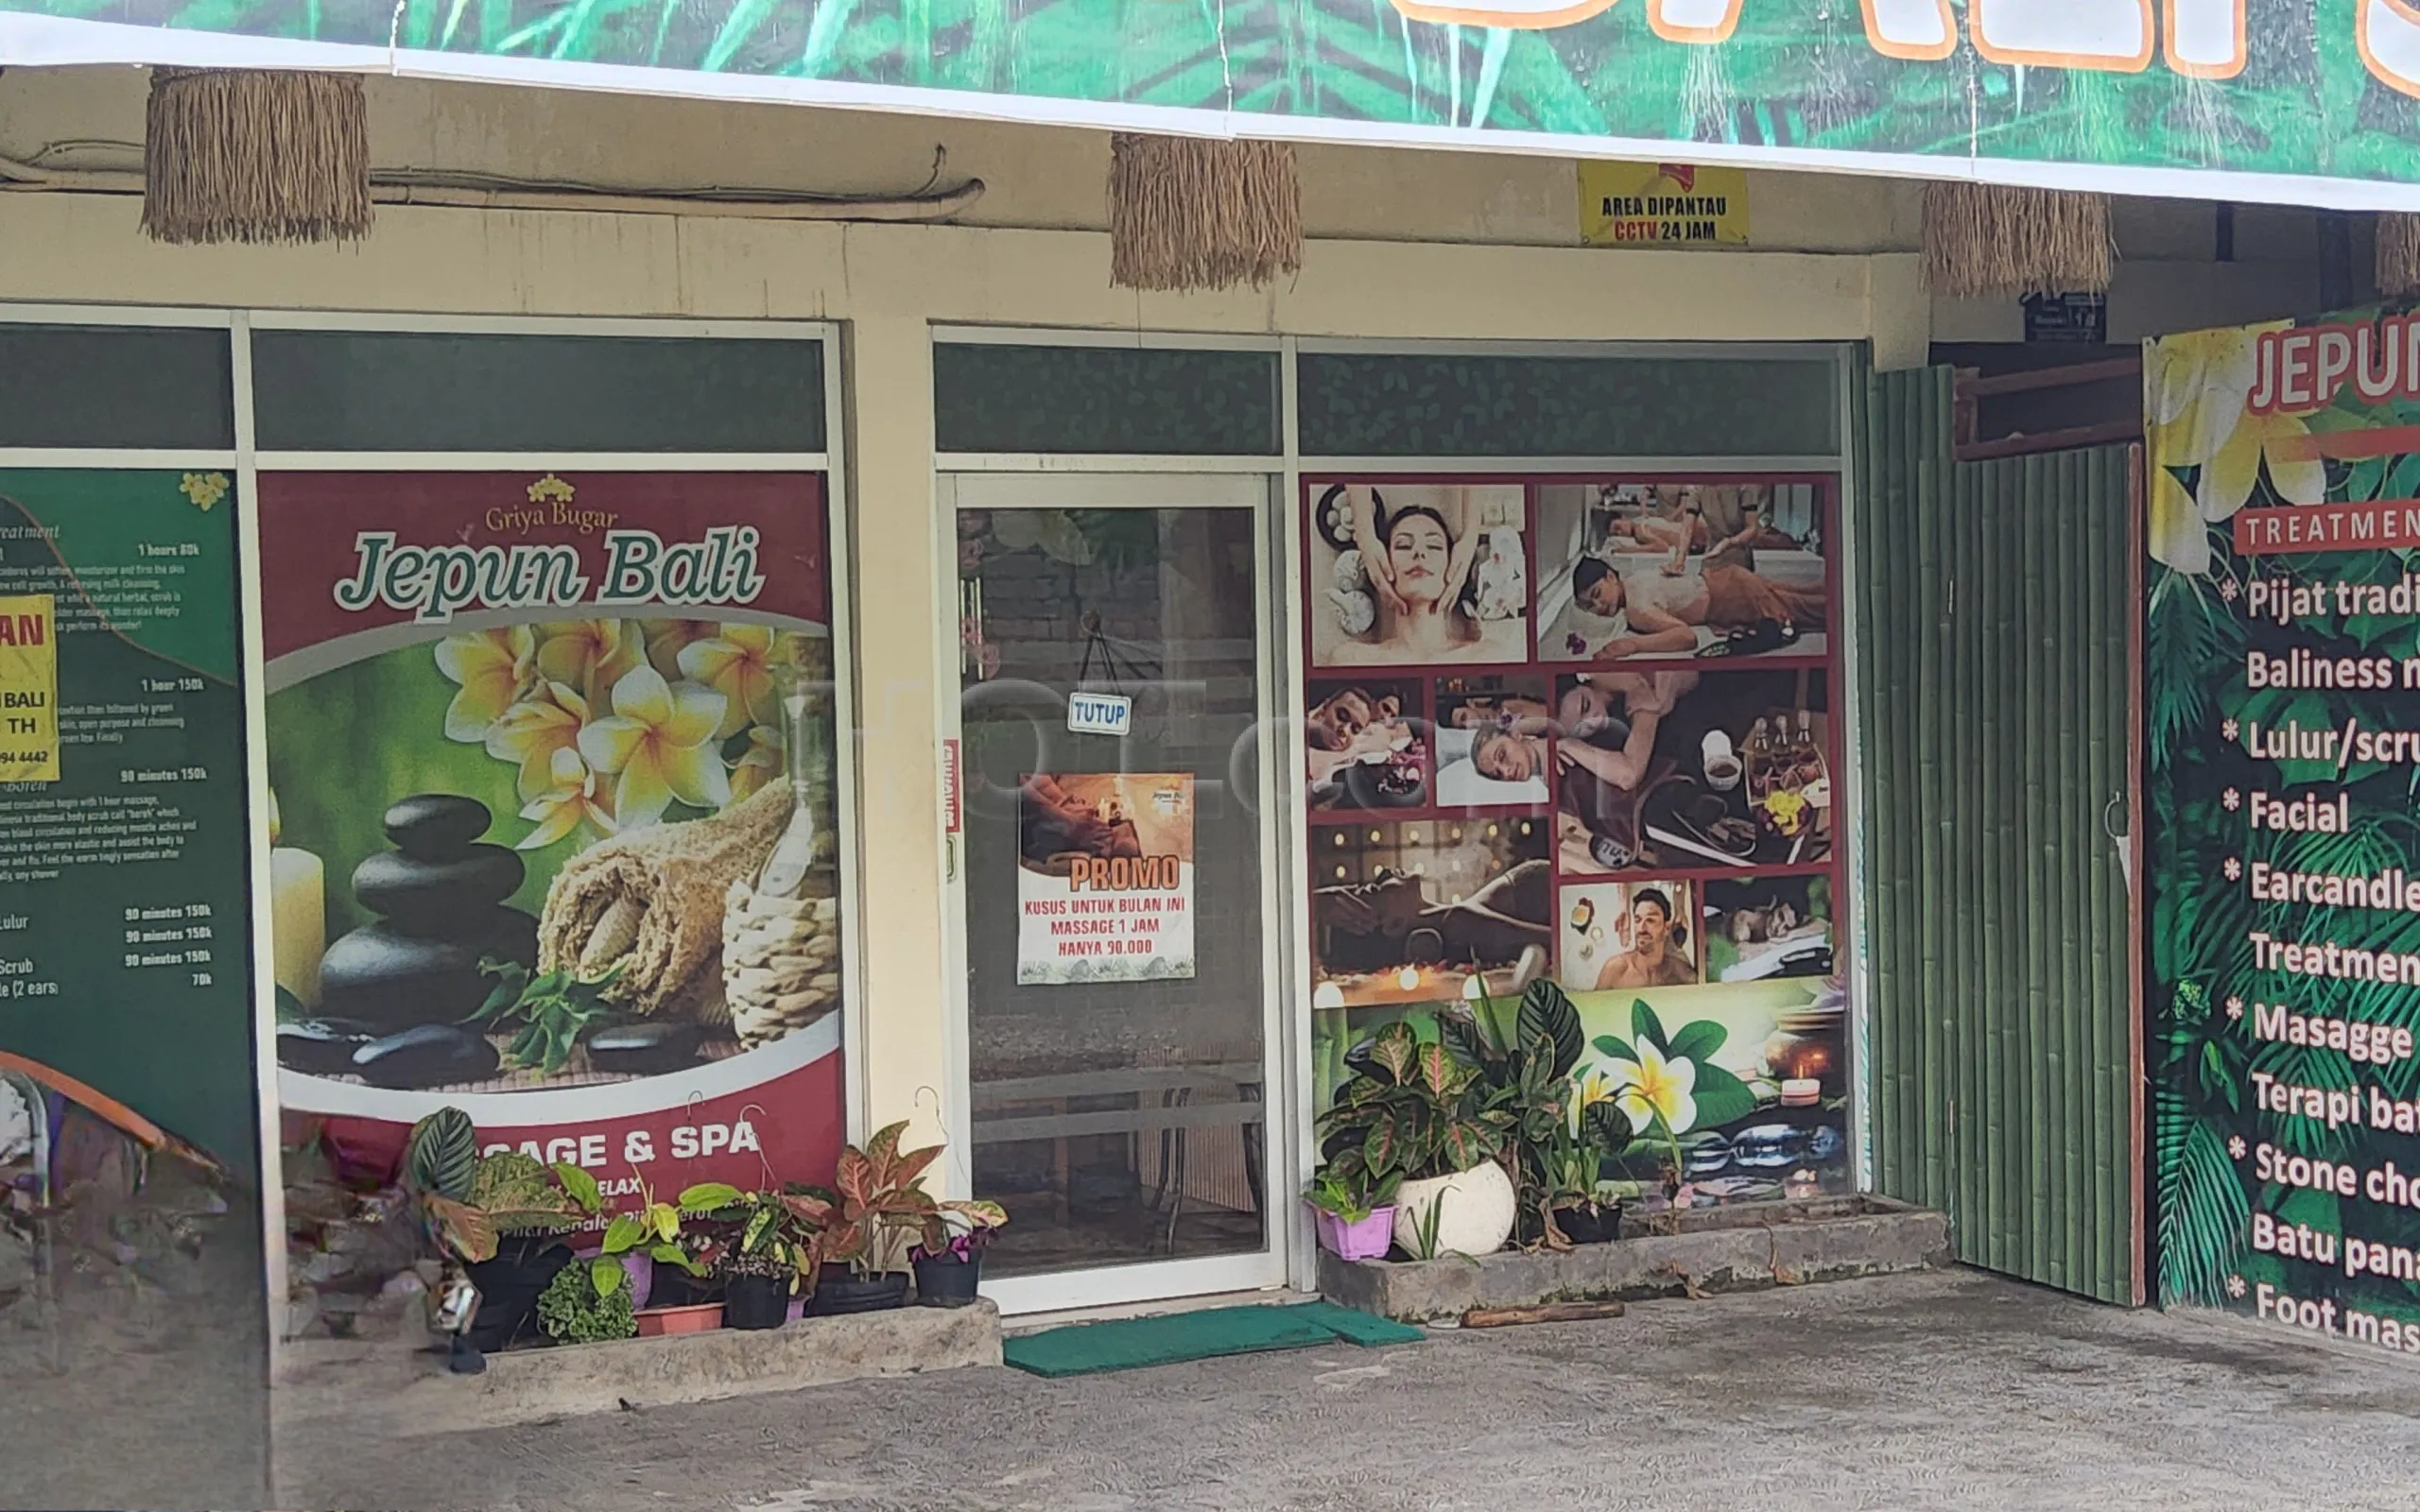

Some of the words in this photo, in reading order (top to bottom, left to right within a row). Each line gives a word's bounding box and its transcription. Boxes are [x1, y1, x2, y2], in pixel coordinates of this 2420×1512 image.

[1601, 197, 1643, 216] AREA
[1648, 196, 1727, 216] DIPANTAU
[1615, 221, 1658, 242] CCTV
[1661, 221, 1682, 241] 24
[1685, 221, 1716, 241] JAM
[484, 504, 546, 536] Griya
[551, 501, 619, 536] Bugar
[2245, 508, 2420, 546] TREATMEN
[334, 531, 591, 625] Jepun
[596, 524, 767, 607] Bali
[2248, 577, 2327, 627] Pijat
[2247, 647, 2394, 689] Baliness
[5, 691, 45, 709] BALI
[1074, 701, 1126, 725] TUTUP
[7, 717, 36, 734] TH
[18, 751, 48, 764] 4442
[2250, 791, 2349, 833] Facial
[1069, 854, 1181, 893] PROMO
[2251, 861, 2420, 912] Earcandle
[1025, 900, 1067, 915] KUSUS
[1071, 899, 1115, 914] UNTUK
[1118, 897, 1162, 913] BULAN
[1166, 896, 1185, 912] INI
[1050, 919, 1115, 936] MASSAGE
[1118, 919, 1126, 934] 1
[1130, 918, 1161, 934] JAM
[1057, 940, 1103, 957] HANYA
[1107, 938, 1153, 955] 90.000
[2248, 932, 2420, 987] Treatmen
[2253, 1003, 2413, 1065] Masagge
[2251, 1072, 2360, 1131] Terapi
[624, 1130, 656, 1163] &
[670, 1121, 760, 1160] SPA
[596, 1177, 641, 1197] ELAX
[2255, 1142, 2358, 1196] Stone
[2253, 1212, 2336, 1264] Batu
[2344, 1236, 2420, 1280] pan
[2256, 1282, 2337, 1339] Foot
